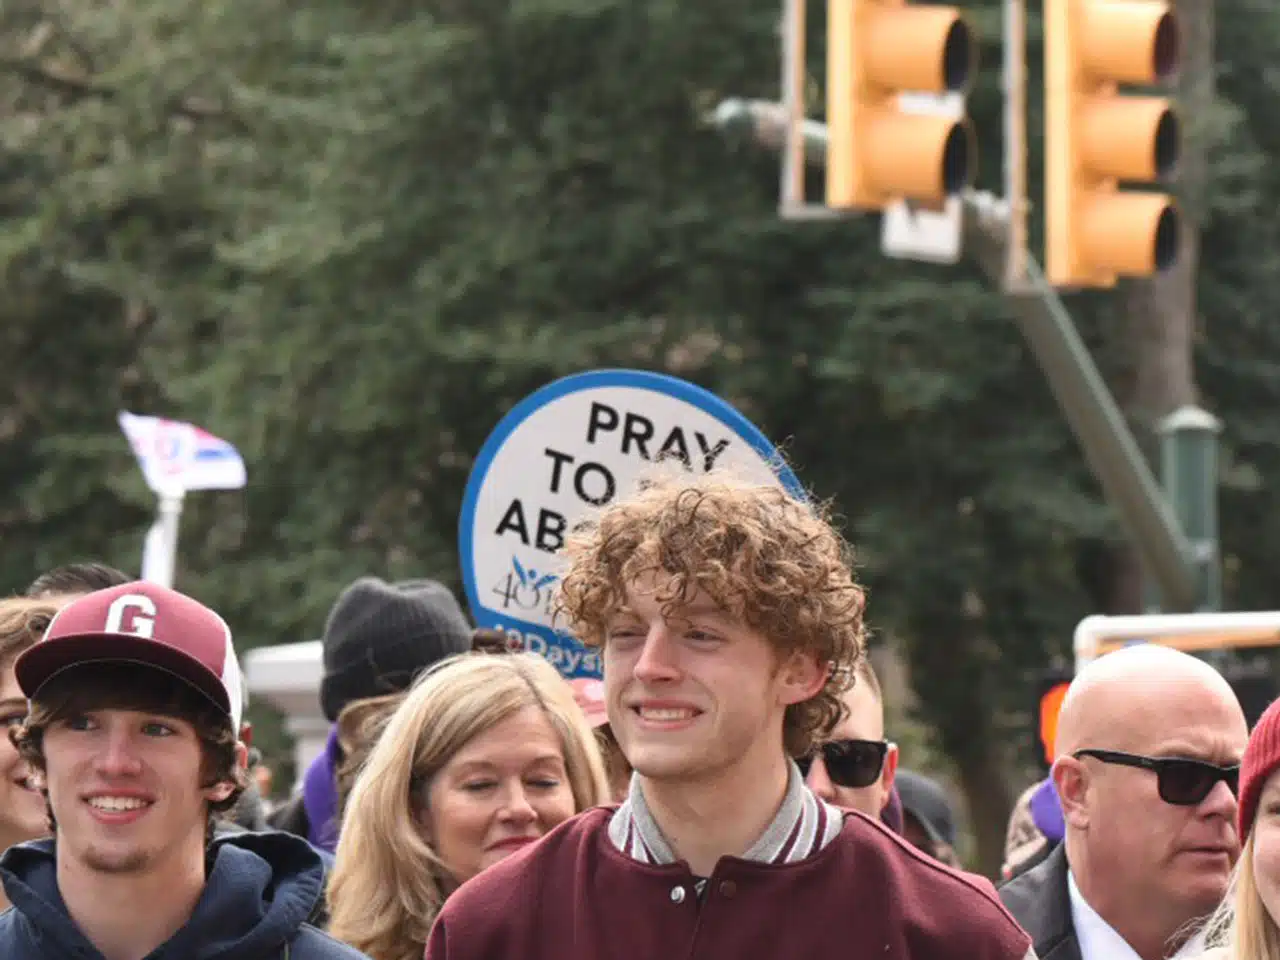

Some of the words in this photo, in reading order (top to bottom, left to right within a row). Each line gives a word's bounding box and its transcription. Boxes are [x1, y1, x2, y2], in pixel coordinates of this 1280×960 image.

[587, 401, 730, 473] PRAY
[544, 447, 617, 507] TO
[495, 498, 570, 554] AB
[104, 594, 157, 639] G
